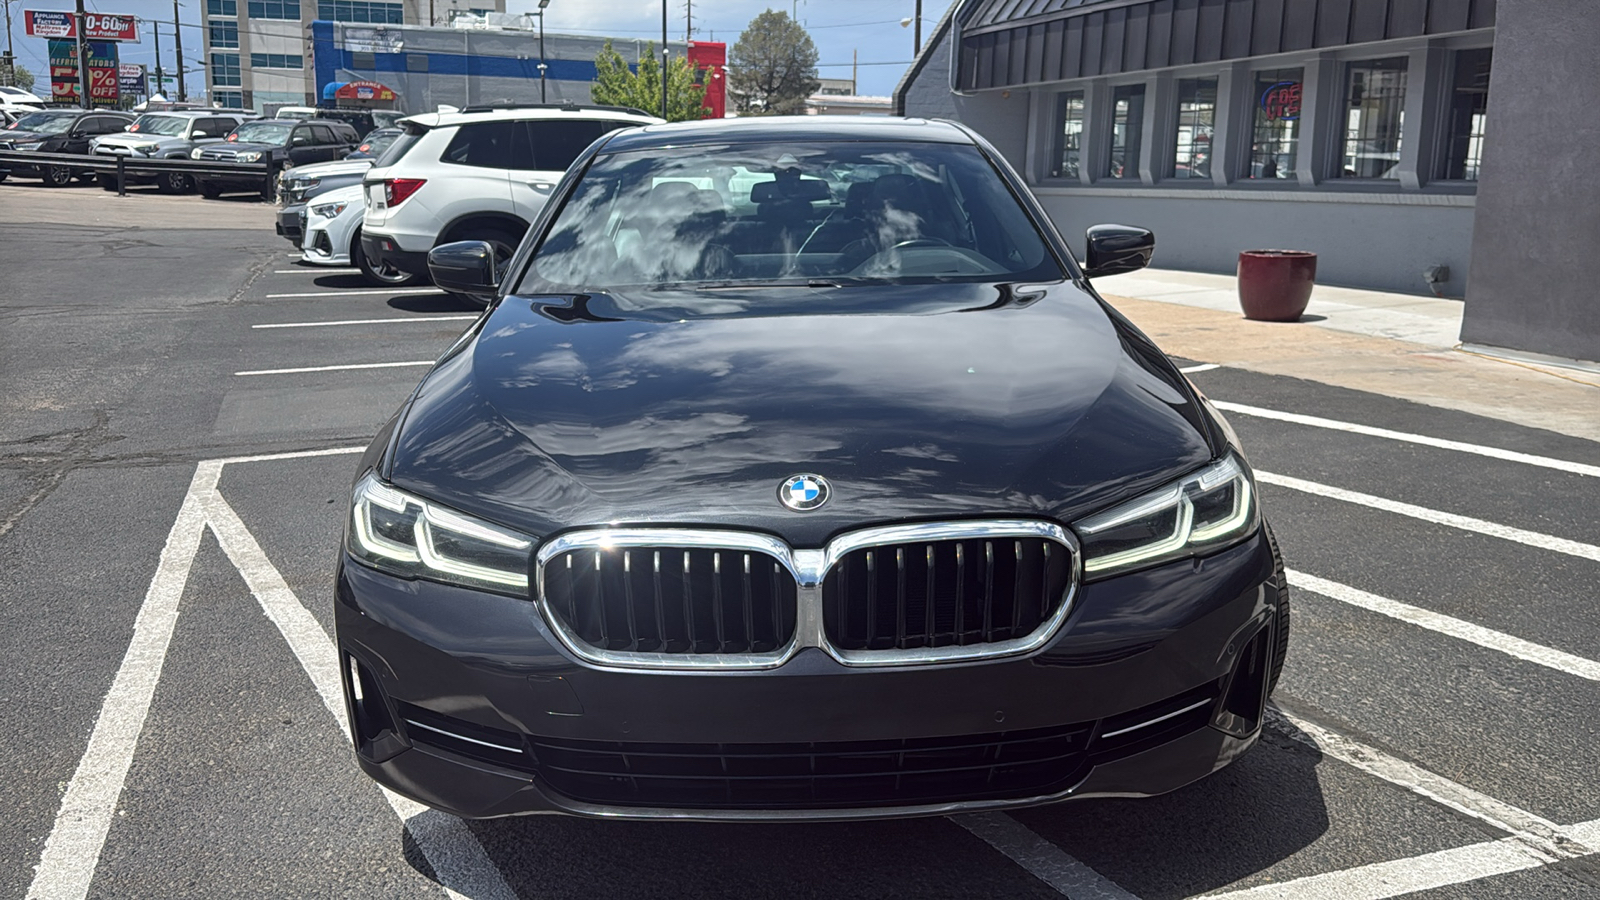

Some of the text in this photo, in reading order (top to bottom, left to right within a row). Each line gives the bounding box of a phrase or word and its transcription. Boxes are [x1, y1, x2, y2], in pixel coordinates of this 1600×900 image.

[349, 81, 381, 89] ENTRANCE
[92, 87, 116, 96] OFF
[90, 96, 118, 105] Delivery
